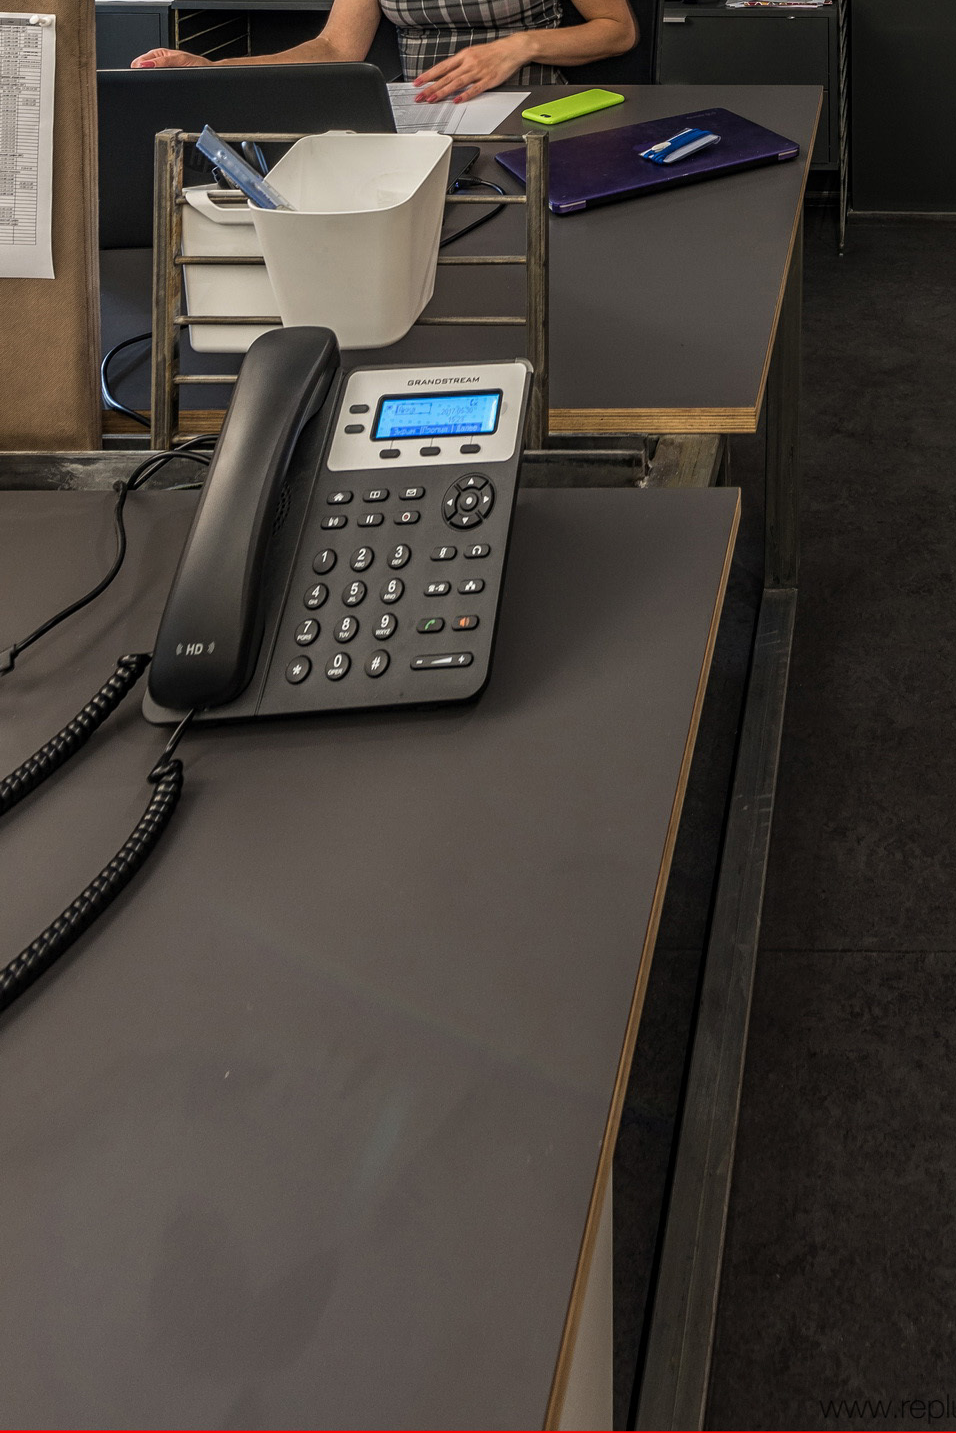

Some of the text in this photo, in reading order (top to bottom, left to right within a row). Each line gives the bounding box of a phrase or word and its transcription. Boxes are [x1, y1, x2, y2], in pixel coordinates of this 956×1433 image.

[407, 376, 480, 386] GRANDSTREAM
[321, 550, 328, 563] 1
[357, 548, 366, 561] 2
[394, 545, 403, 558] 3
[311, 585, 321, 598] 4
[350, 582, 359, 595] 5
[388, 579, 397, 593] 6
[304, 620, 313, 634] 7
[341, 617, 351, 631] 8
[381, 614, 390, 628] 9
[185, 643, 204, 656] HD
[333, 653, 343, 668] 0
